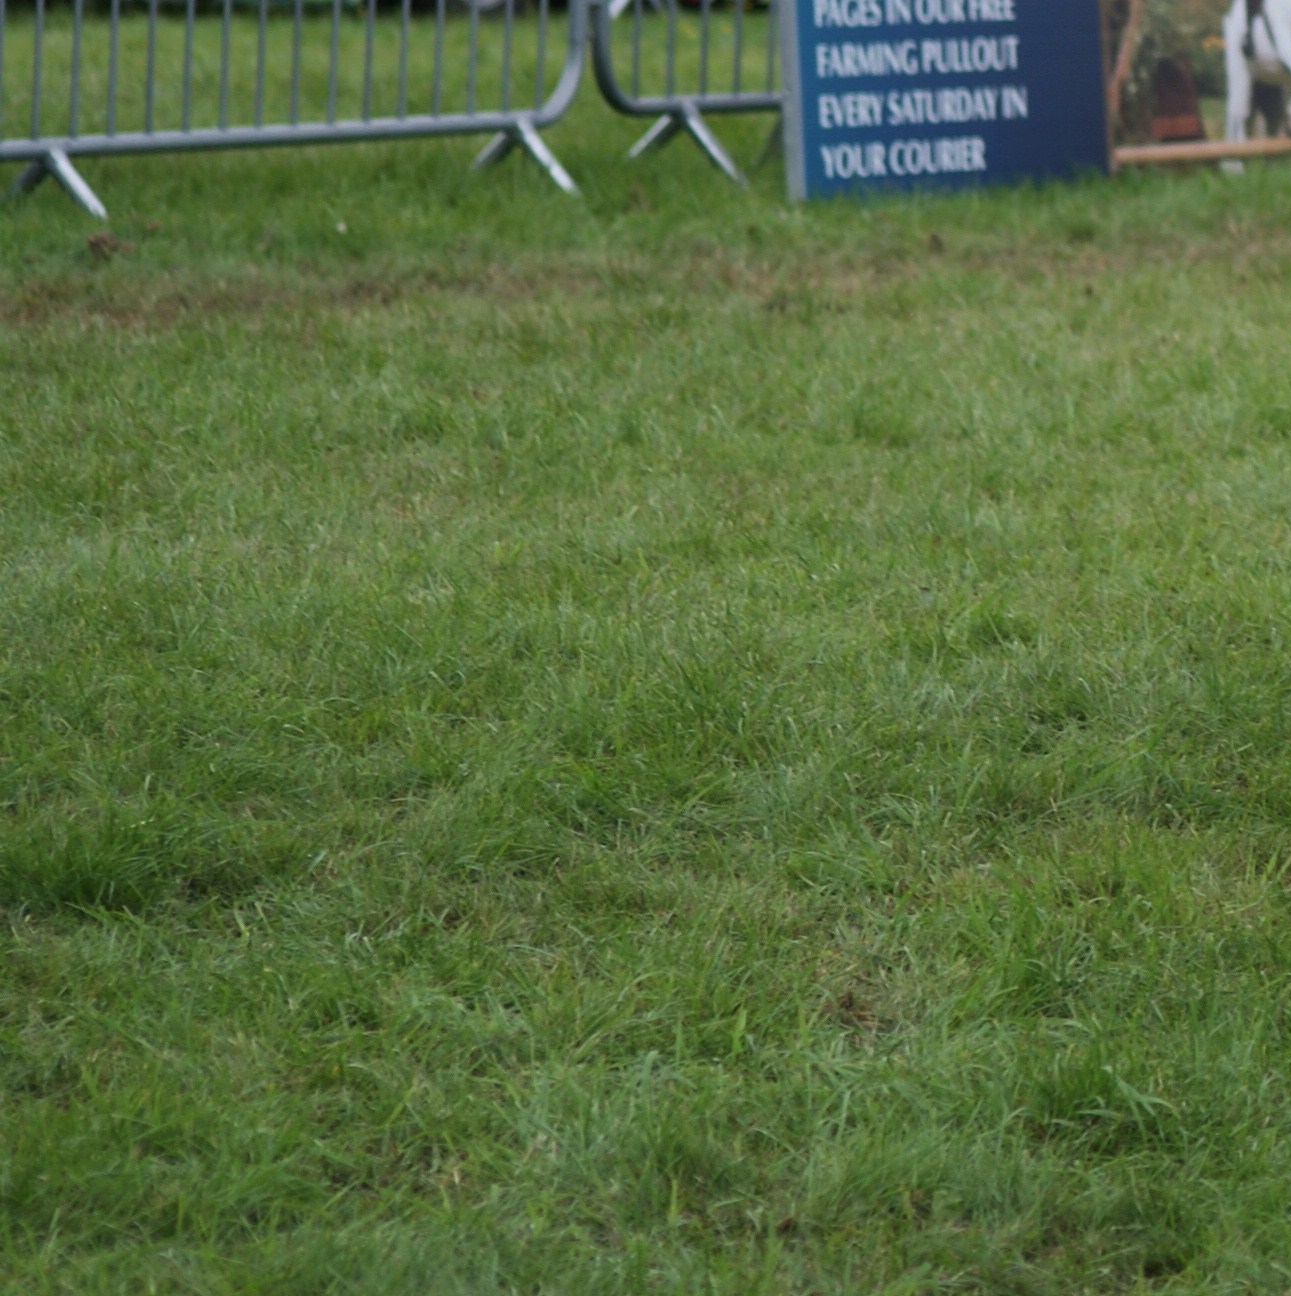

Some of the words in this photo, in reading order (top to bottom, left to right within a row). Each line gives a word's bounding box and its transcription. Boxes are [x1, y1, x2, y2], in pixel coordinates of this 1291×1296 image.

[816, 39, 918, 78] FARMING
[921, 35, 1020, 74] PULLOUT
[819, 92, 885, 129] EVERY
[887, 86, 999, 125] SATURDAY
[1000, 84, 1029, 120] IN
[820, 144, 887, 179] YOUR
[889, 136, 987, 176] COURIER
